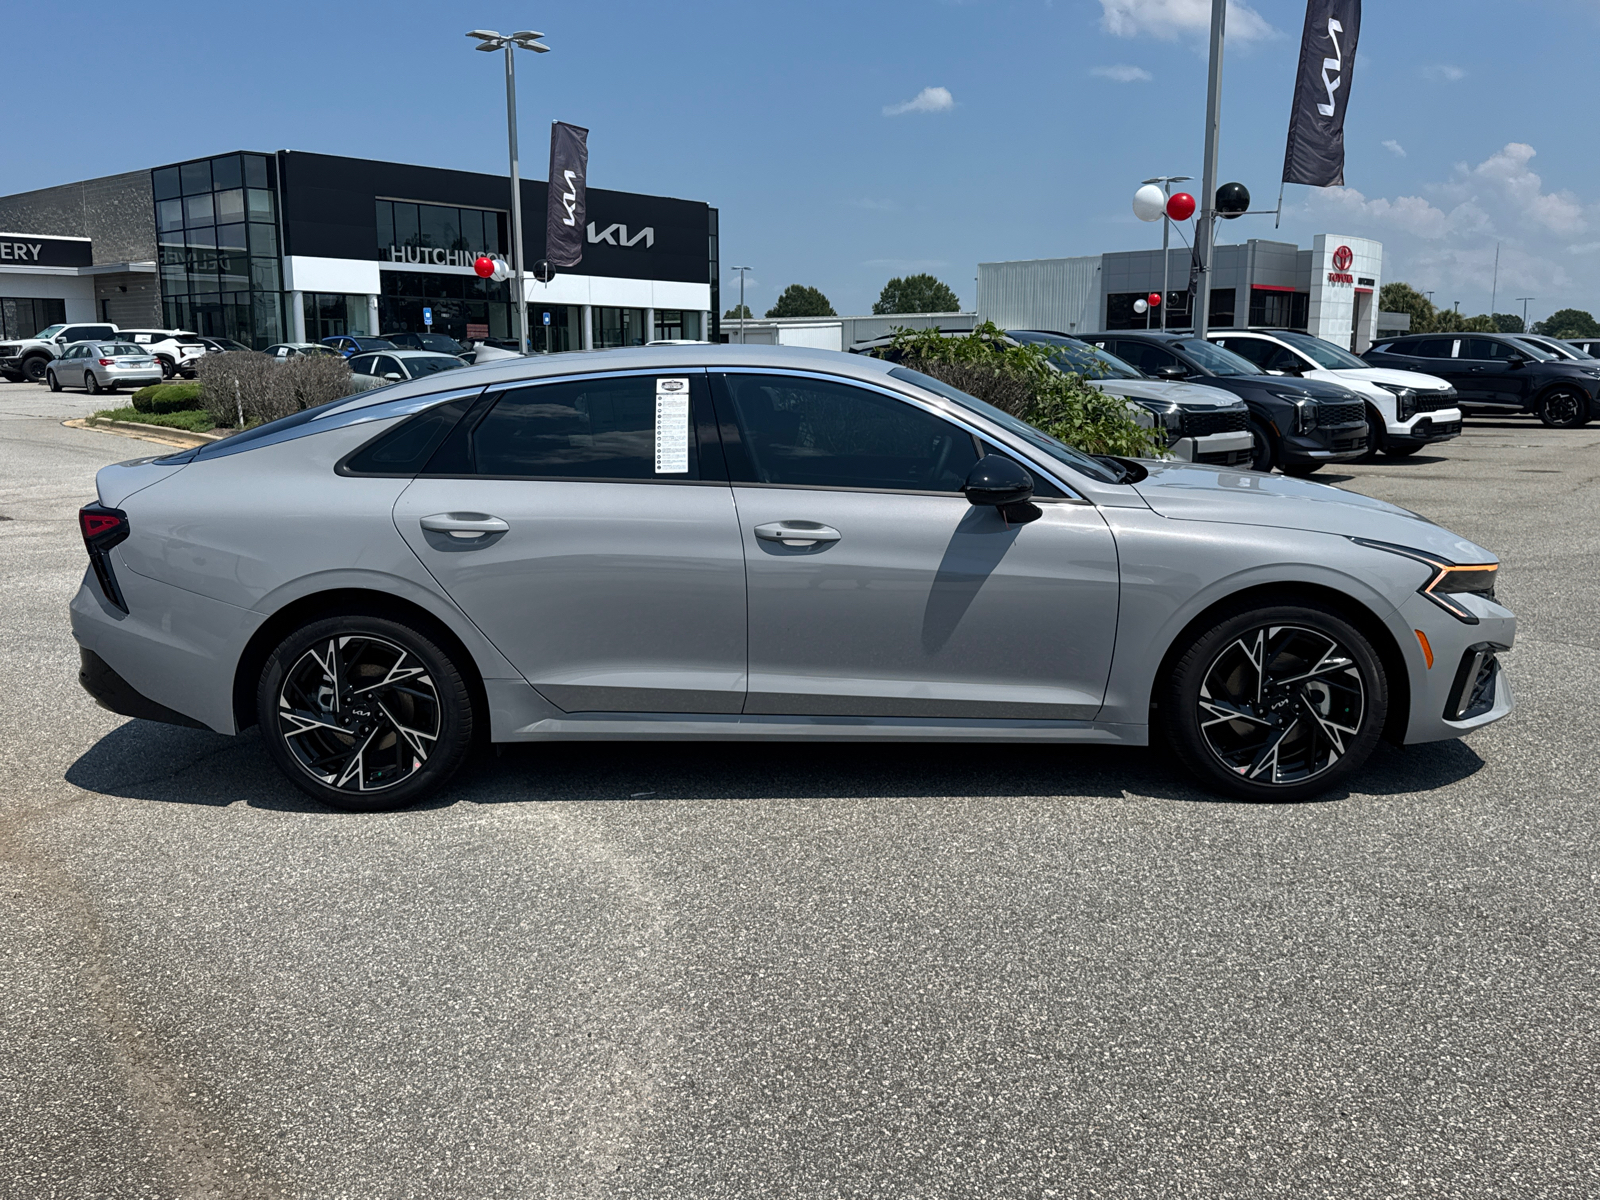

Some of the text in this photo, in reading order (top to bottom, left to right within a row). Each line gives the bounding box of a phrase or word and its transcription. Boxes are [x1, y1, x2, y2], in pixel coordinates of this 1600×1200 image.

[1317, 17, 1343, 117] KIA
[563, 169, 576, 227] KIA
[586, 221, 654, 249] KIA
[0, 242, 42, 260] ERY
[1328, 272, 1353, 284] TOYOTA
